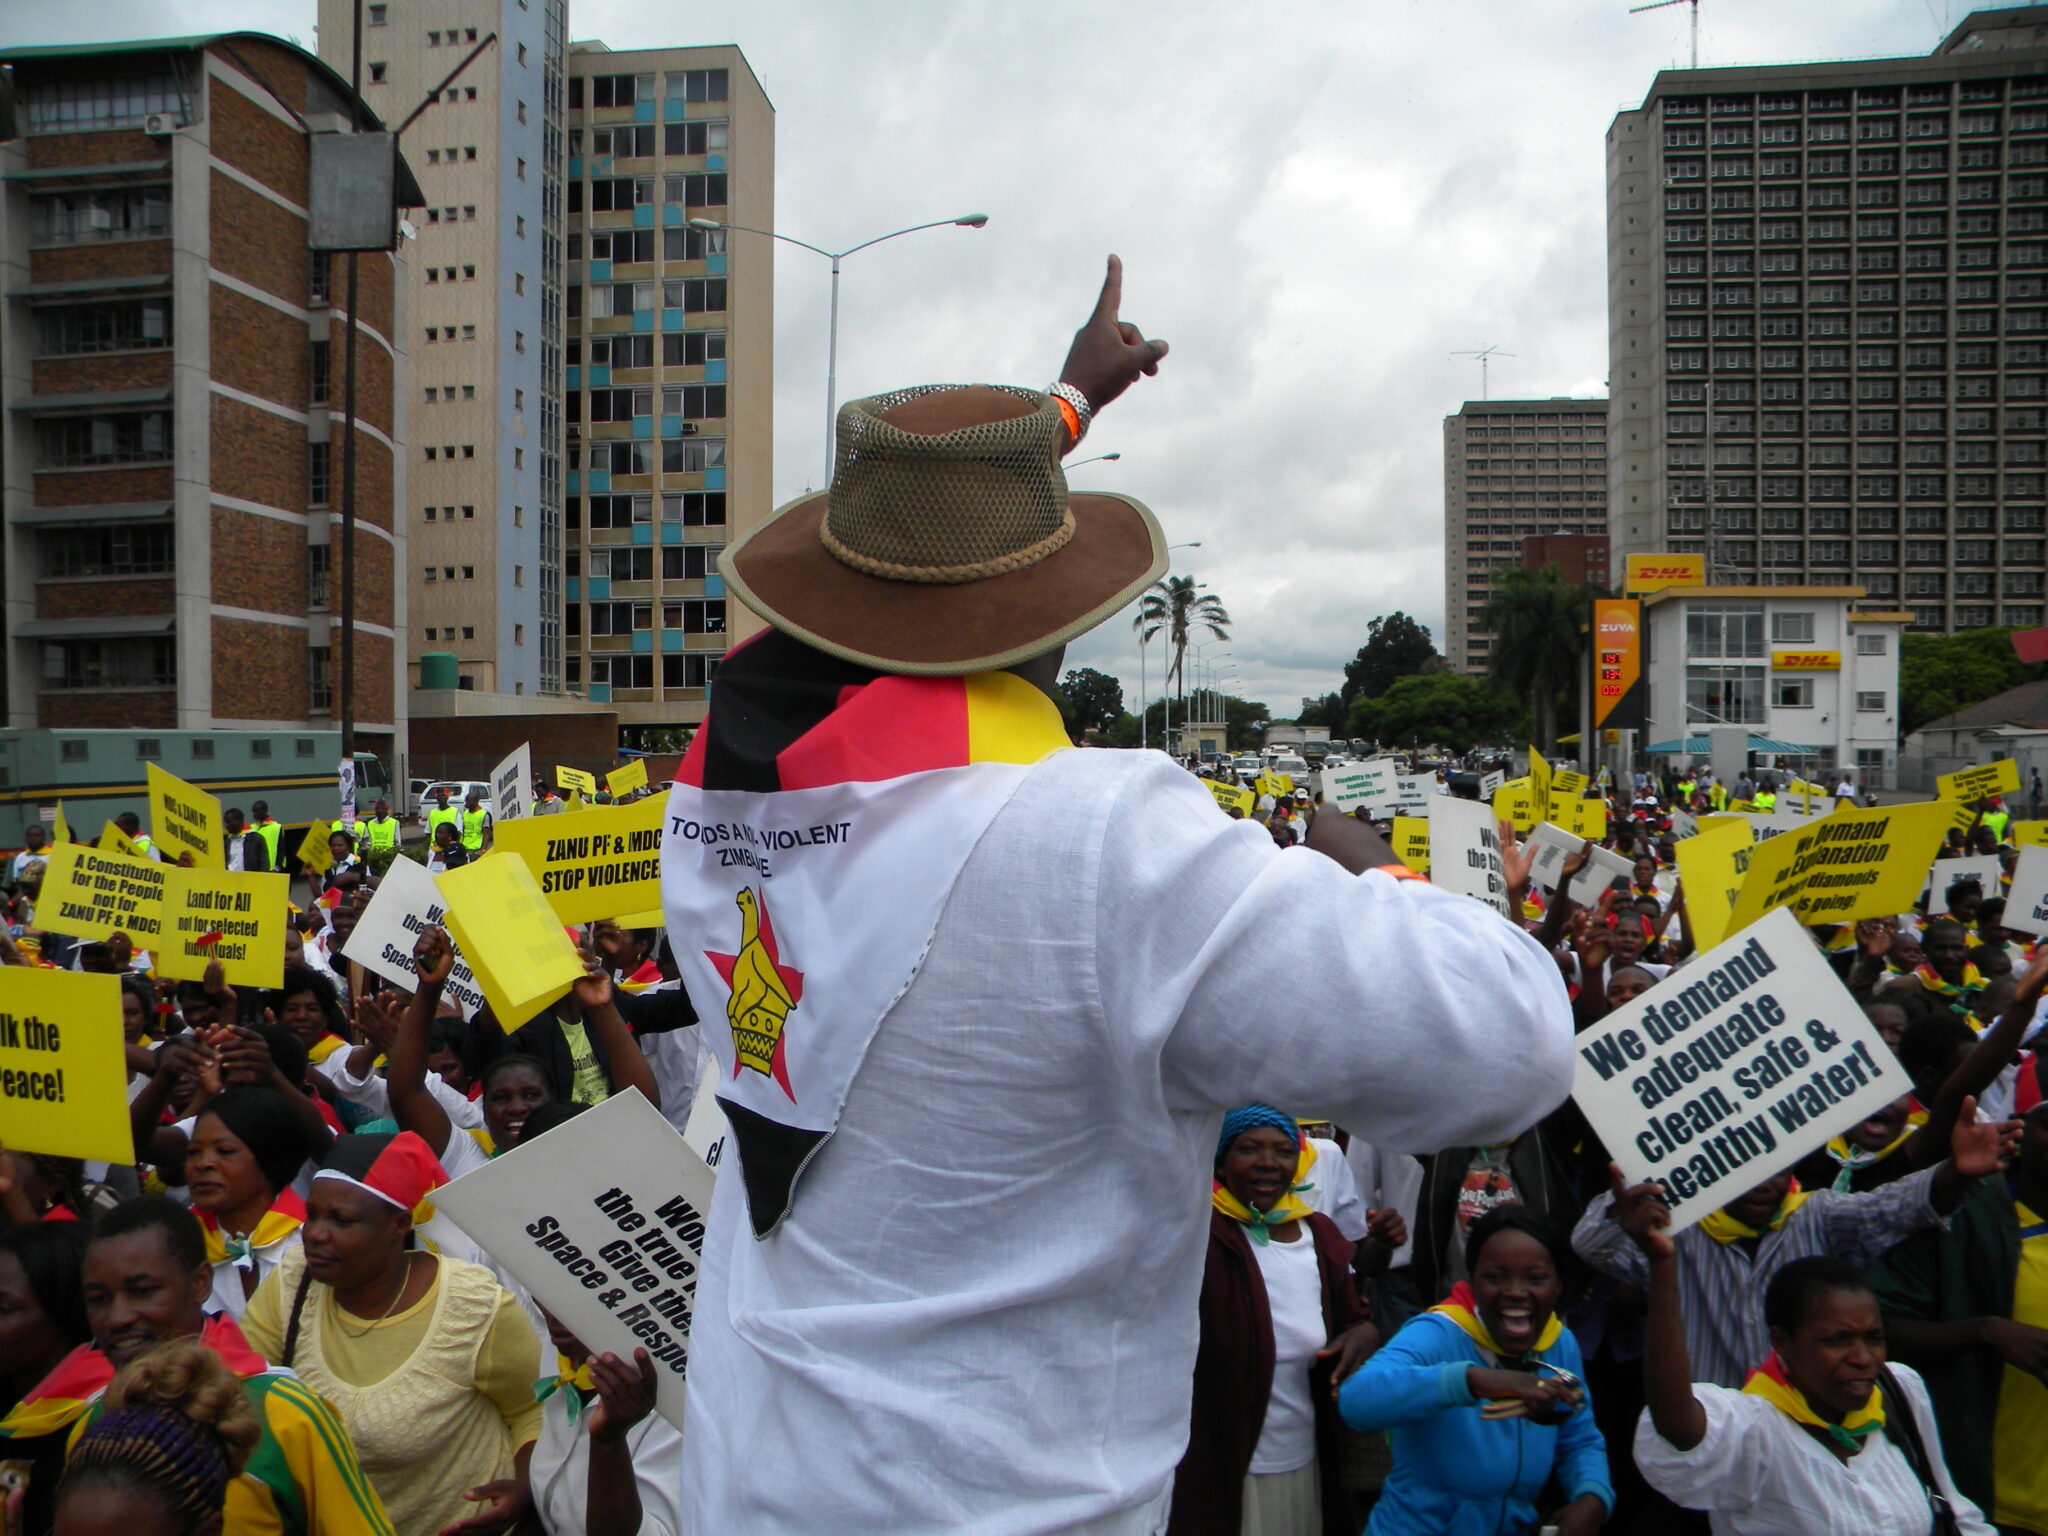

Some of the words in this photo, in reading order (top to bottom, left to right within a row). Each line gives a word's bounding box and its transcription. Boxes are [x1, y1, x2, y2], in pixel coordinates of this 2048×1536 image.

[1638, 568, 1693, 579] DHL
[1600, 624, 1634, 632] ZUVA
[1783, 655, 1831, 666] DHL
[1408, 835, 1426, 846] ZANU
[1814, 816, 1891, 847] Demand
[546, 836, 589, 862] ZANU
[592, 834, 612, 857] PF
[613, 836, 625, 854] &
[628, 828, 662, 852] MDC
[1406, 848, 1424, 858] STOP
[74, 854, 84, 868] A
[1467, 848, 1487, 870] the
[72, 870, 92, 886] for
[94, 875, 117, 892] the
[542, 868, 585, 894] STOP
[1807, 869, 1880, 888] diamonds
[92, 894, 117, 908] not
[118, 896, 138, 912] for
[186, 888, 214, 910] Land
[214, 891, 233, 911] for
[234, 892, 251, 912] All
[1810, 892, 1860, 913] going!
[59, 902, 96, 922] ZANU
[96, 908, 114, 924] PF
[114, 914, 124, 927] &
[126, 914, 162, 934] MDC!
[178, 916, 192, 931] not
[210, 918, 258, 937] selected
[1580, 1028, 1647, 1082] We
[1641, 937, 1777, 1046] demand
[0, 1013, 20, 1048] lk
[24, 1016, 61, 1052] the
[1632, 993, 1786, 1110] adequate
[1636, 1086, 1742, 1164] clean,
[1732, 1035, 1810, 1100] safe
[1805, 1018, 1842, 1053] &
[1768, 1040, 1883, 1135] water!
[594, 1187, 646, 1232] the
[634, 1227, 696, 1280] true
[525, 1216, 608, 1290] Space
[598, 1288, 627, 1310] &
[616, 1303, 688, 1382] Respe
[598, 1239, 660, 1293] Give
[648, 1288, 692, 1338] the
